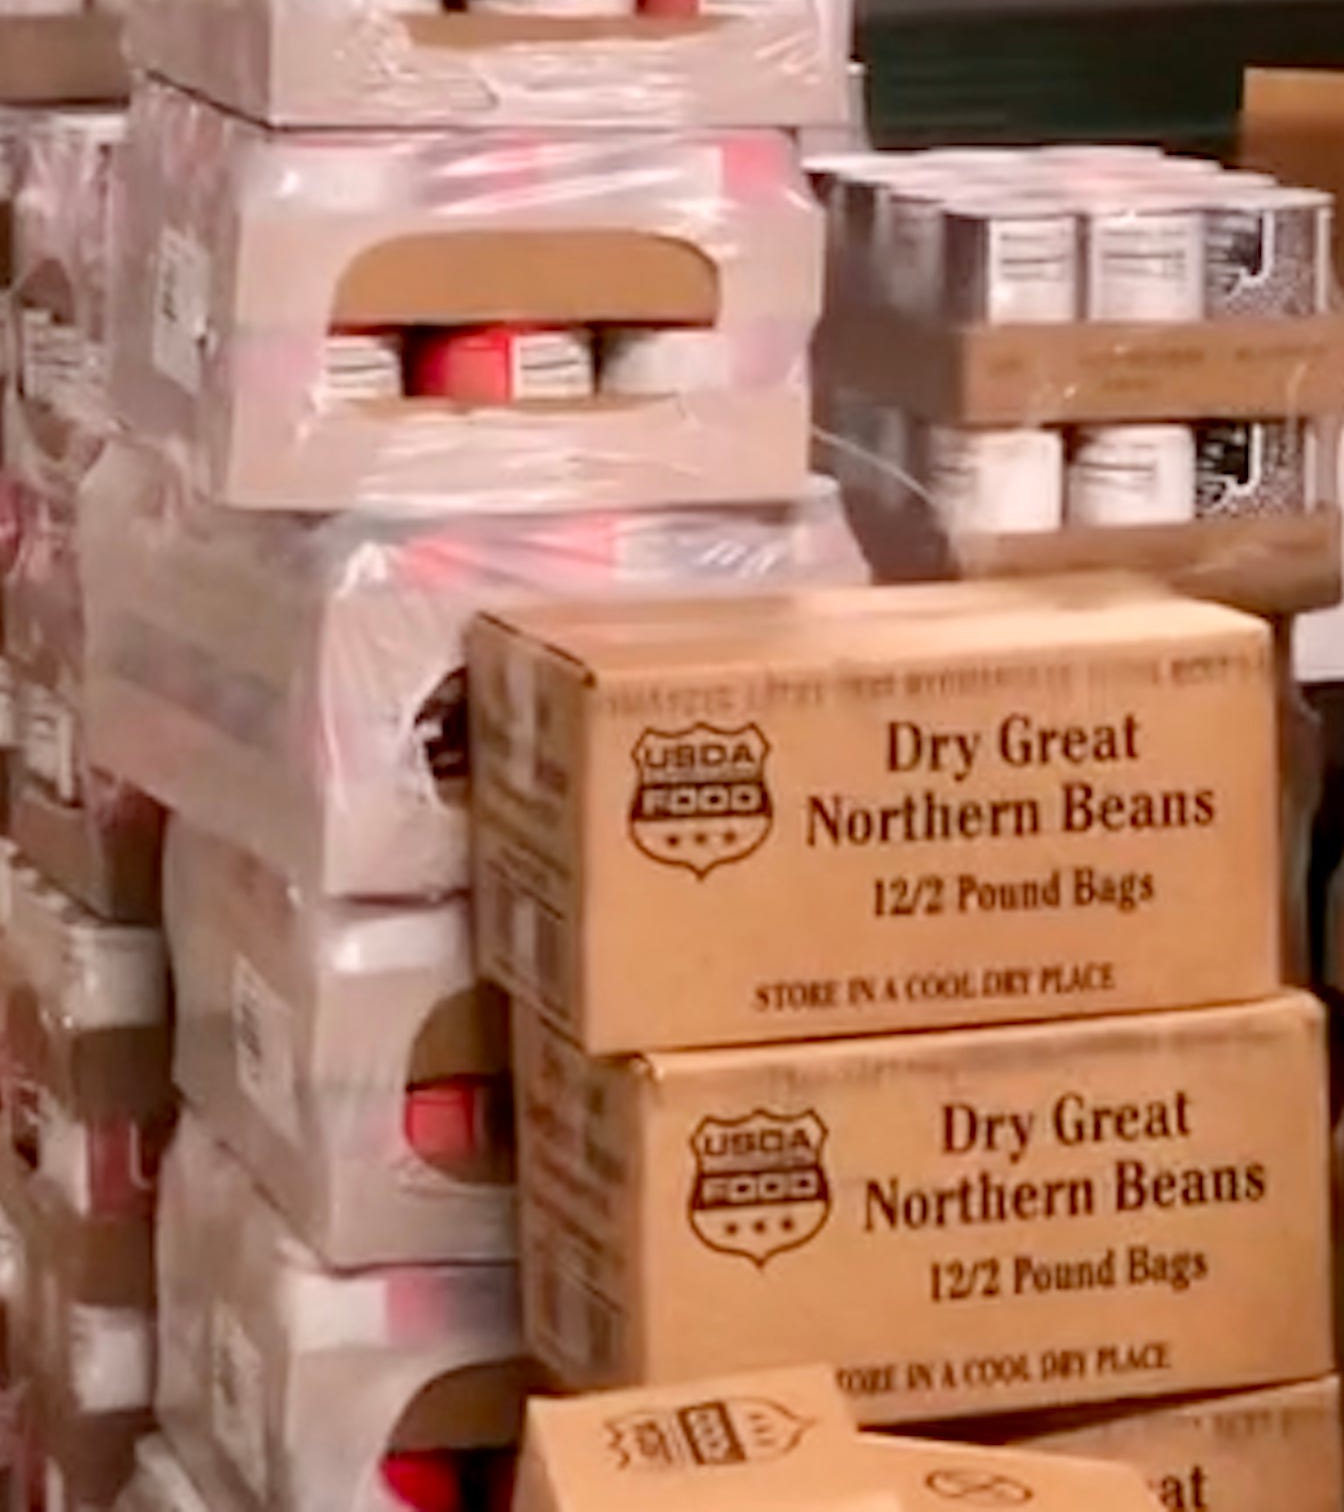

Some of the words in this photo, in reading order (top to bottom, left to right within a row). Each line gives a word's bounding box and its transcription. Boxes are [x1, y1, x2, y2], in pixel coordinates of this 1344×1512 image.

[644, 744, 756, 769] USDA
[886, 720, 980, 782] Dry
[999, 714, 1140, 768] Great
[642, 785, 760, 816] FOOD
[805, 790, 1040, 847] Northern
[1060, 782, 1216, 833] Beans
[873, 876, 945, 918] 12/2
[957, 868, 1060, 913] Pound
[1073, 866, 1154, 913] Bags
[754, 978, 839, 1013] STORE
[848, 975, 880, 1007] IN
[882, 974, 902, 1003] A
[905, 970, 978, 1001] COOL
[980, 966, 1030, 997] DRY
[1038, 961, 1116, 995] PLACE
[703, 1128, 811, 1156] USDA
[941, 1102, 1034, 1164] Dry
[1053, 1090, 1192, 1147] Great
[702, 1172, 818, 1204] FOOD
[864, 1171, 1095, 1232] Northern
[1115, 1160, 1267, 1213] Beans
[929, 1258, 1001, 1303] 12/2
[1013, 1248, 1116, 1296] Pound
[1127, 1244, 1208, 1294] Bags
[834, 1363, 897, 1397] TORE
[905, 1360, 934, 1390] IN
[940, 1359, 958, 1388] A
[963, 1350, 1032, 1386] COOL
[1040, 1348, 1087, 1382] DRY
[1095, 1341, 1172, 1375] PLACE
